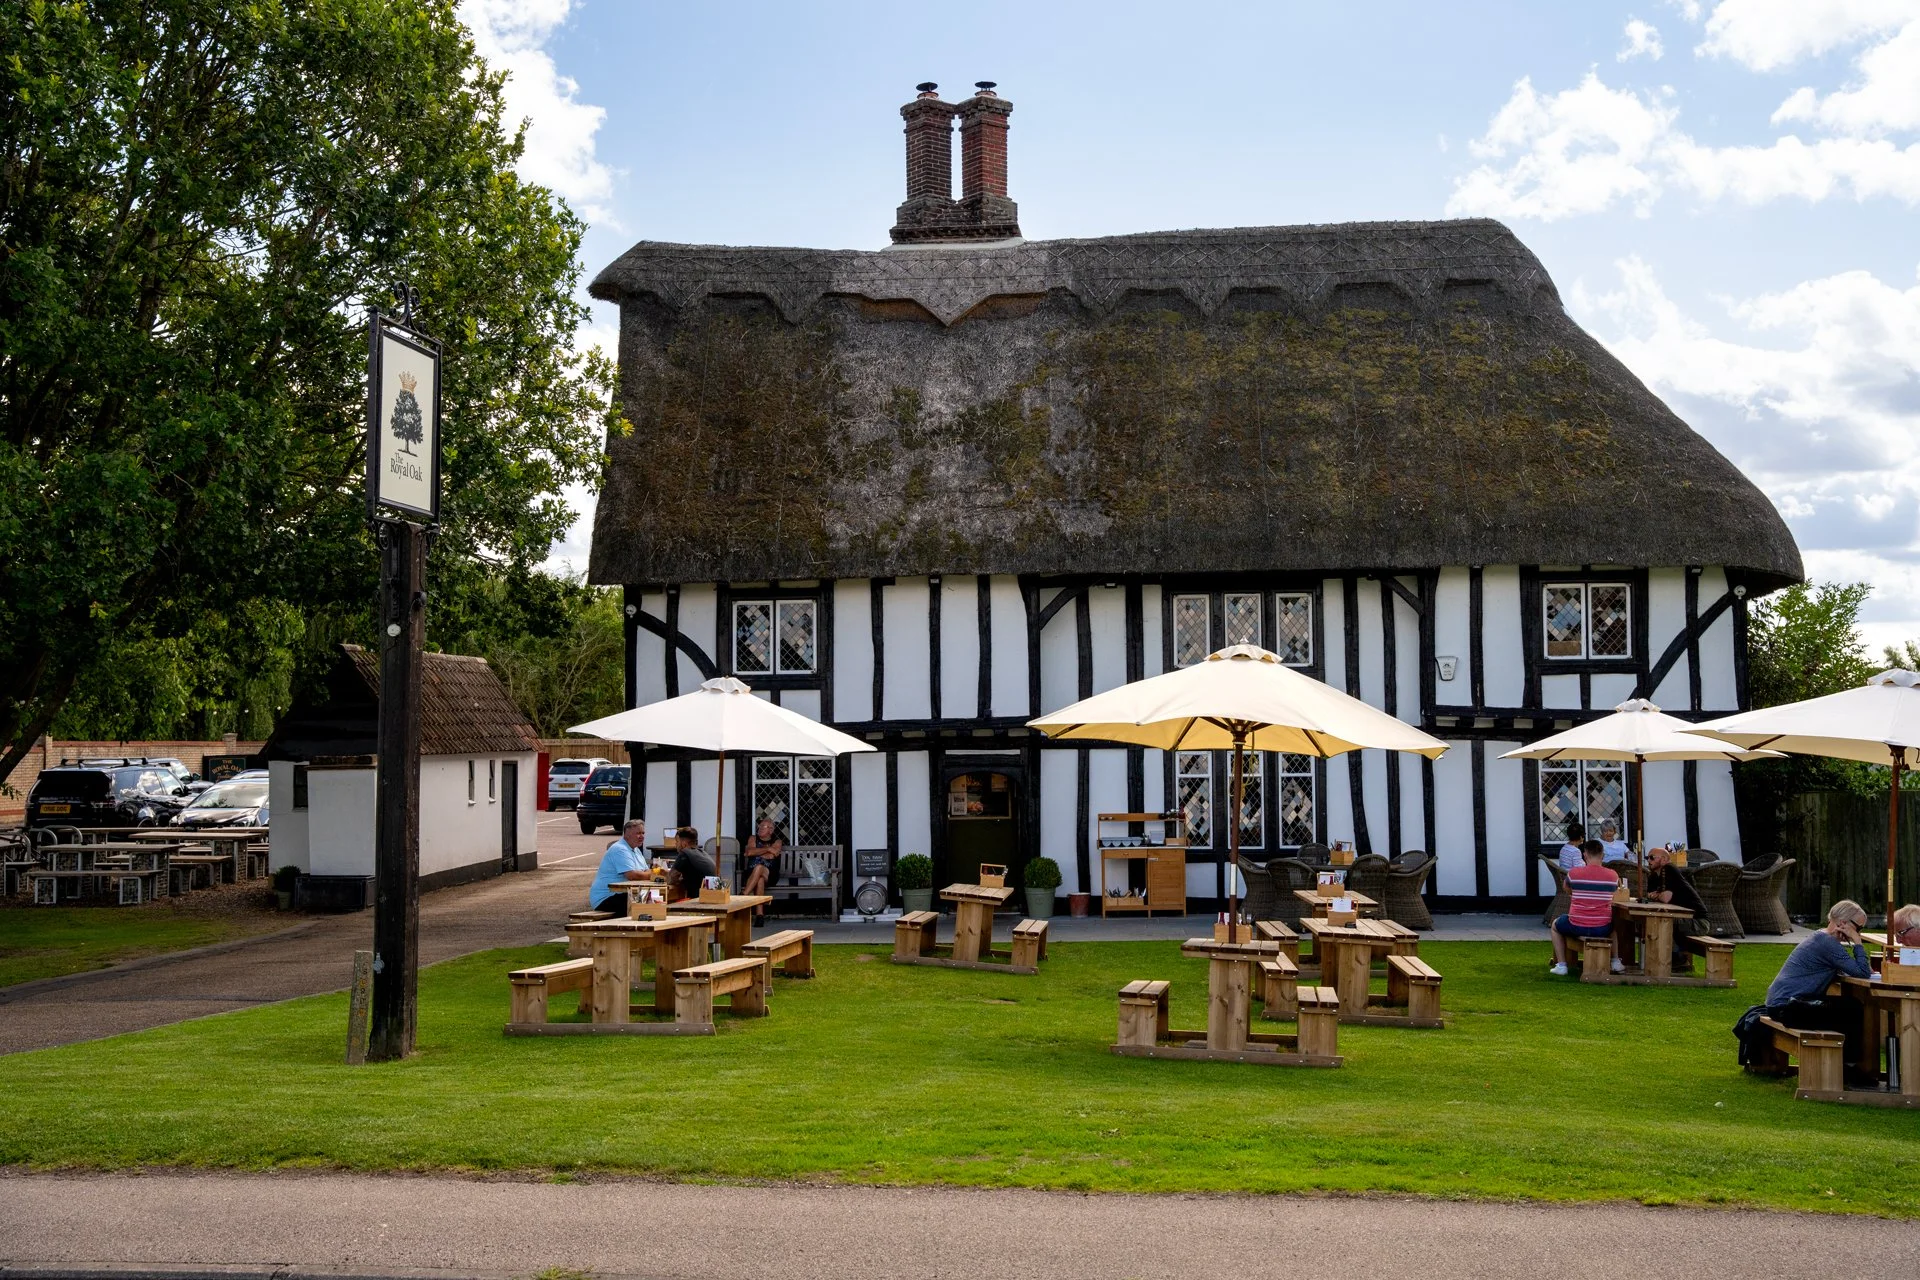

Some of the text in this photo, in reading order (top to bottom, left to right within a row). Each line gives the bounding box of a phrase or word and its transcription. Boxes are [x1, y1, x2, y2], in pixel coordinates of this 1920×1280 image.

[395, 452, 403, 464] The
[390, 458, 423, 481] Royal Oak
[211, 764, 230, 774] ROYAL
